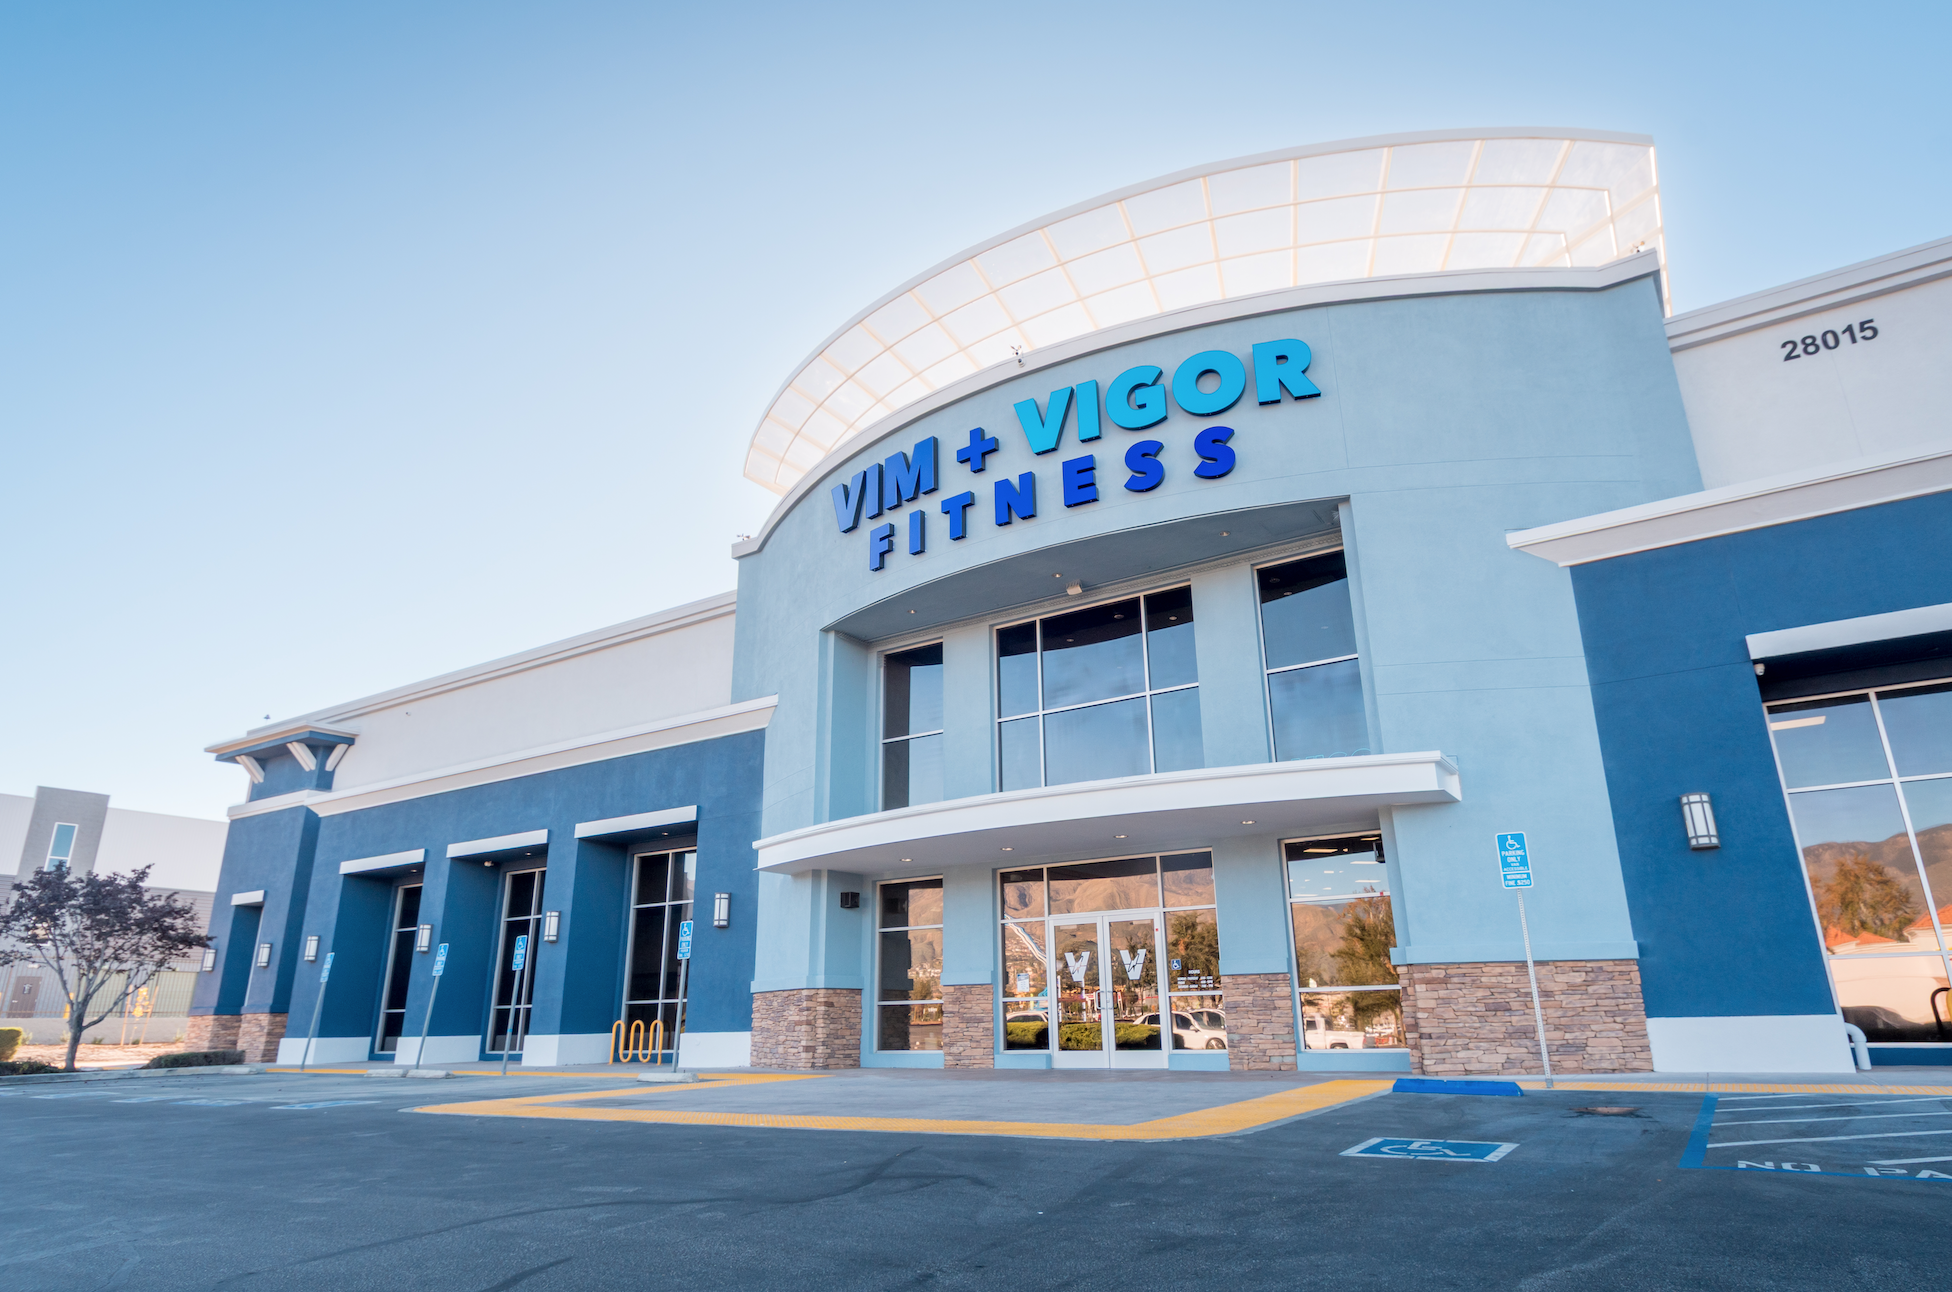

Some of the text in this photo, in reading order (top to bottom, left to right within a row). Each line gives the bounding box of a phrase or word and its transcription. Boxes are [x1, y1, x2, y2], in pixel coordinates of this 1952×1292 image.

[1780, 318, 1879, 362] 28015
[831, 436, 939, 534] VIM
[1013, 338, 1322, 455] VIGOR
[869, 426, 1237, 572] FITNESS
[1737, 1160, 1822, 1172] NO
